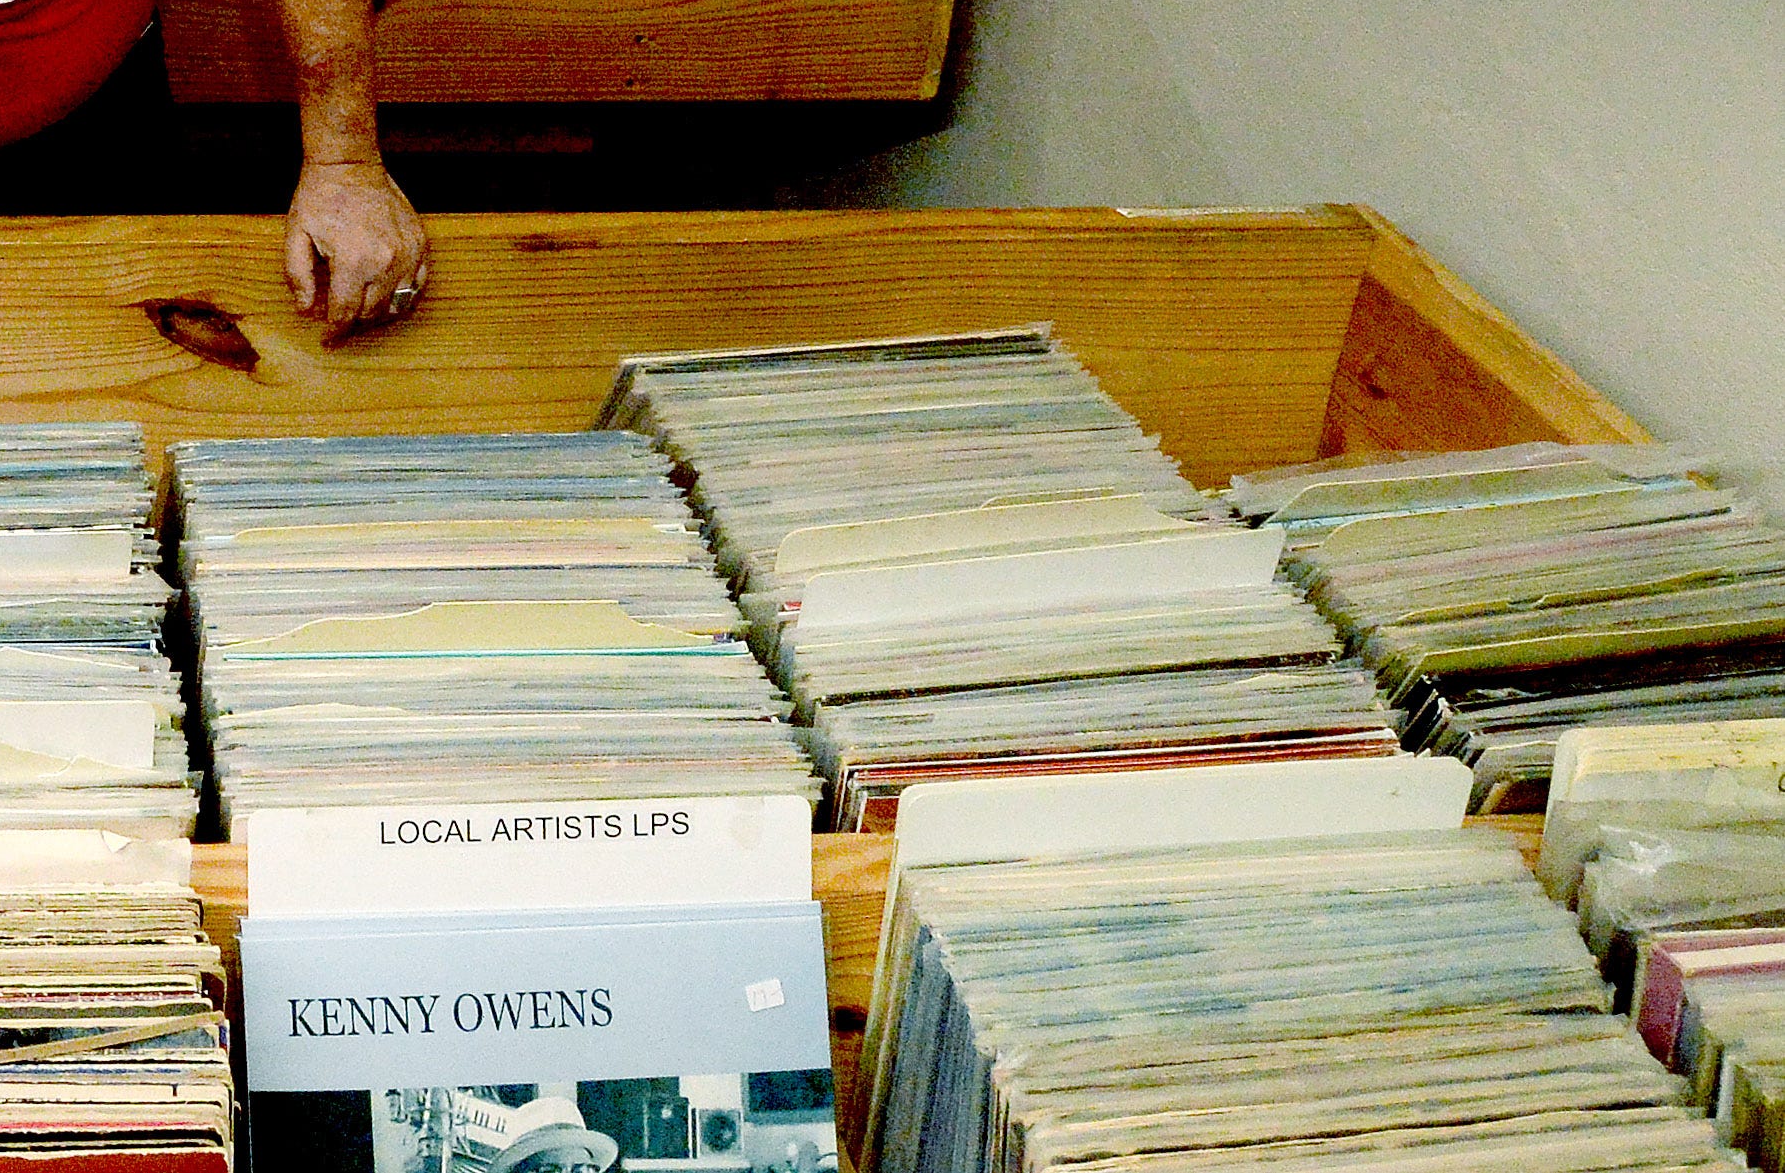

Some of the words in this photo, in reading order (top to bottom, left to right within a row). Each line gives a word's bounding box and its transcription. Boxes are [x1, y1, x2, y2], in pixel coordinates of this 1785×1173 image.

[380, 817, 482, 846] LOCAL
[491, 813, 623, 843] ARTISTS
[632, 811, 691, 837] LPS
[288, 994, 441, 1039] KENNY
[452, 988, 614, 1034] OWENS
